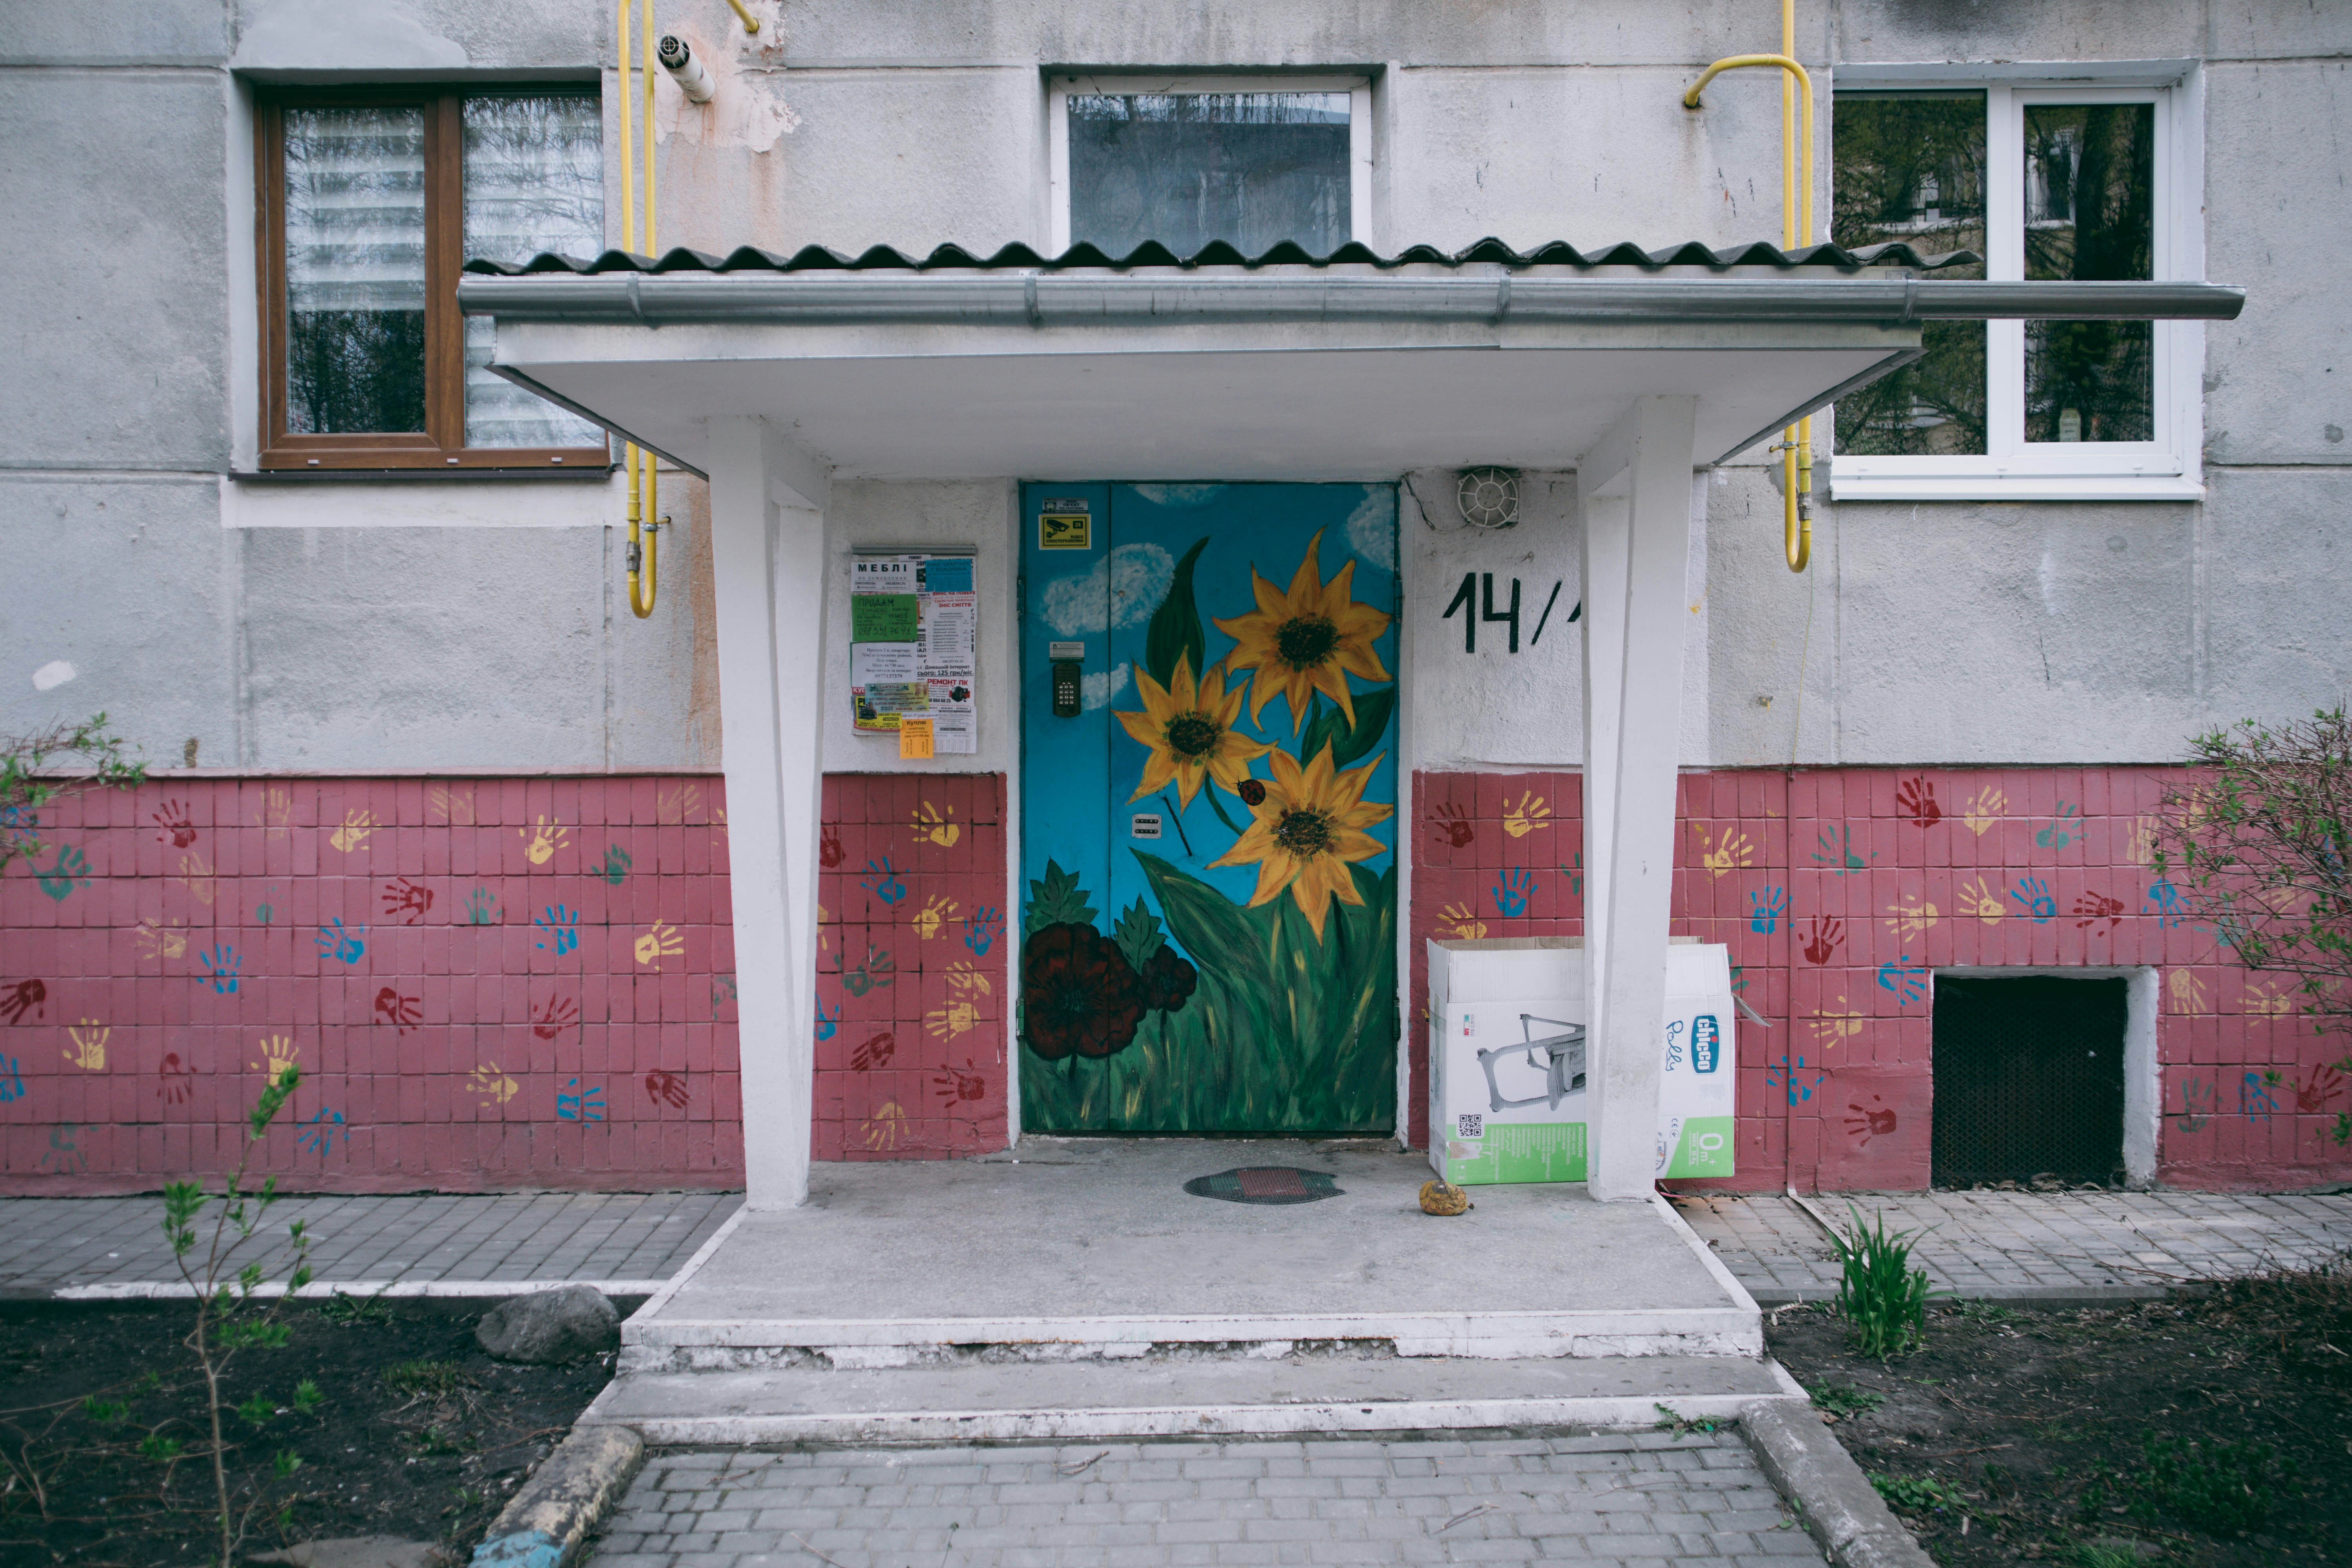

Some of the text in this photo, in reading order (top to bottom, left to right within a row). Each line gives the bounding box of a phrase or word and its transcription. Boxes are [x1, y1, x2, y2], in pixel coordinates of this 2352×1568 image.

[859, 599, 894, 608] ПРОДАМ
[1442, 572, 1581, 653] 14/
[1666, 1020, 1684, 1071] Polly
[1696, 1018, 1718, 1071] chicco
